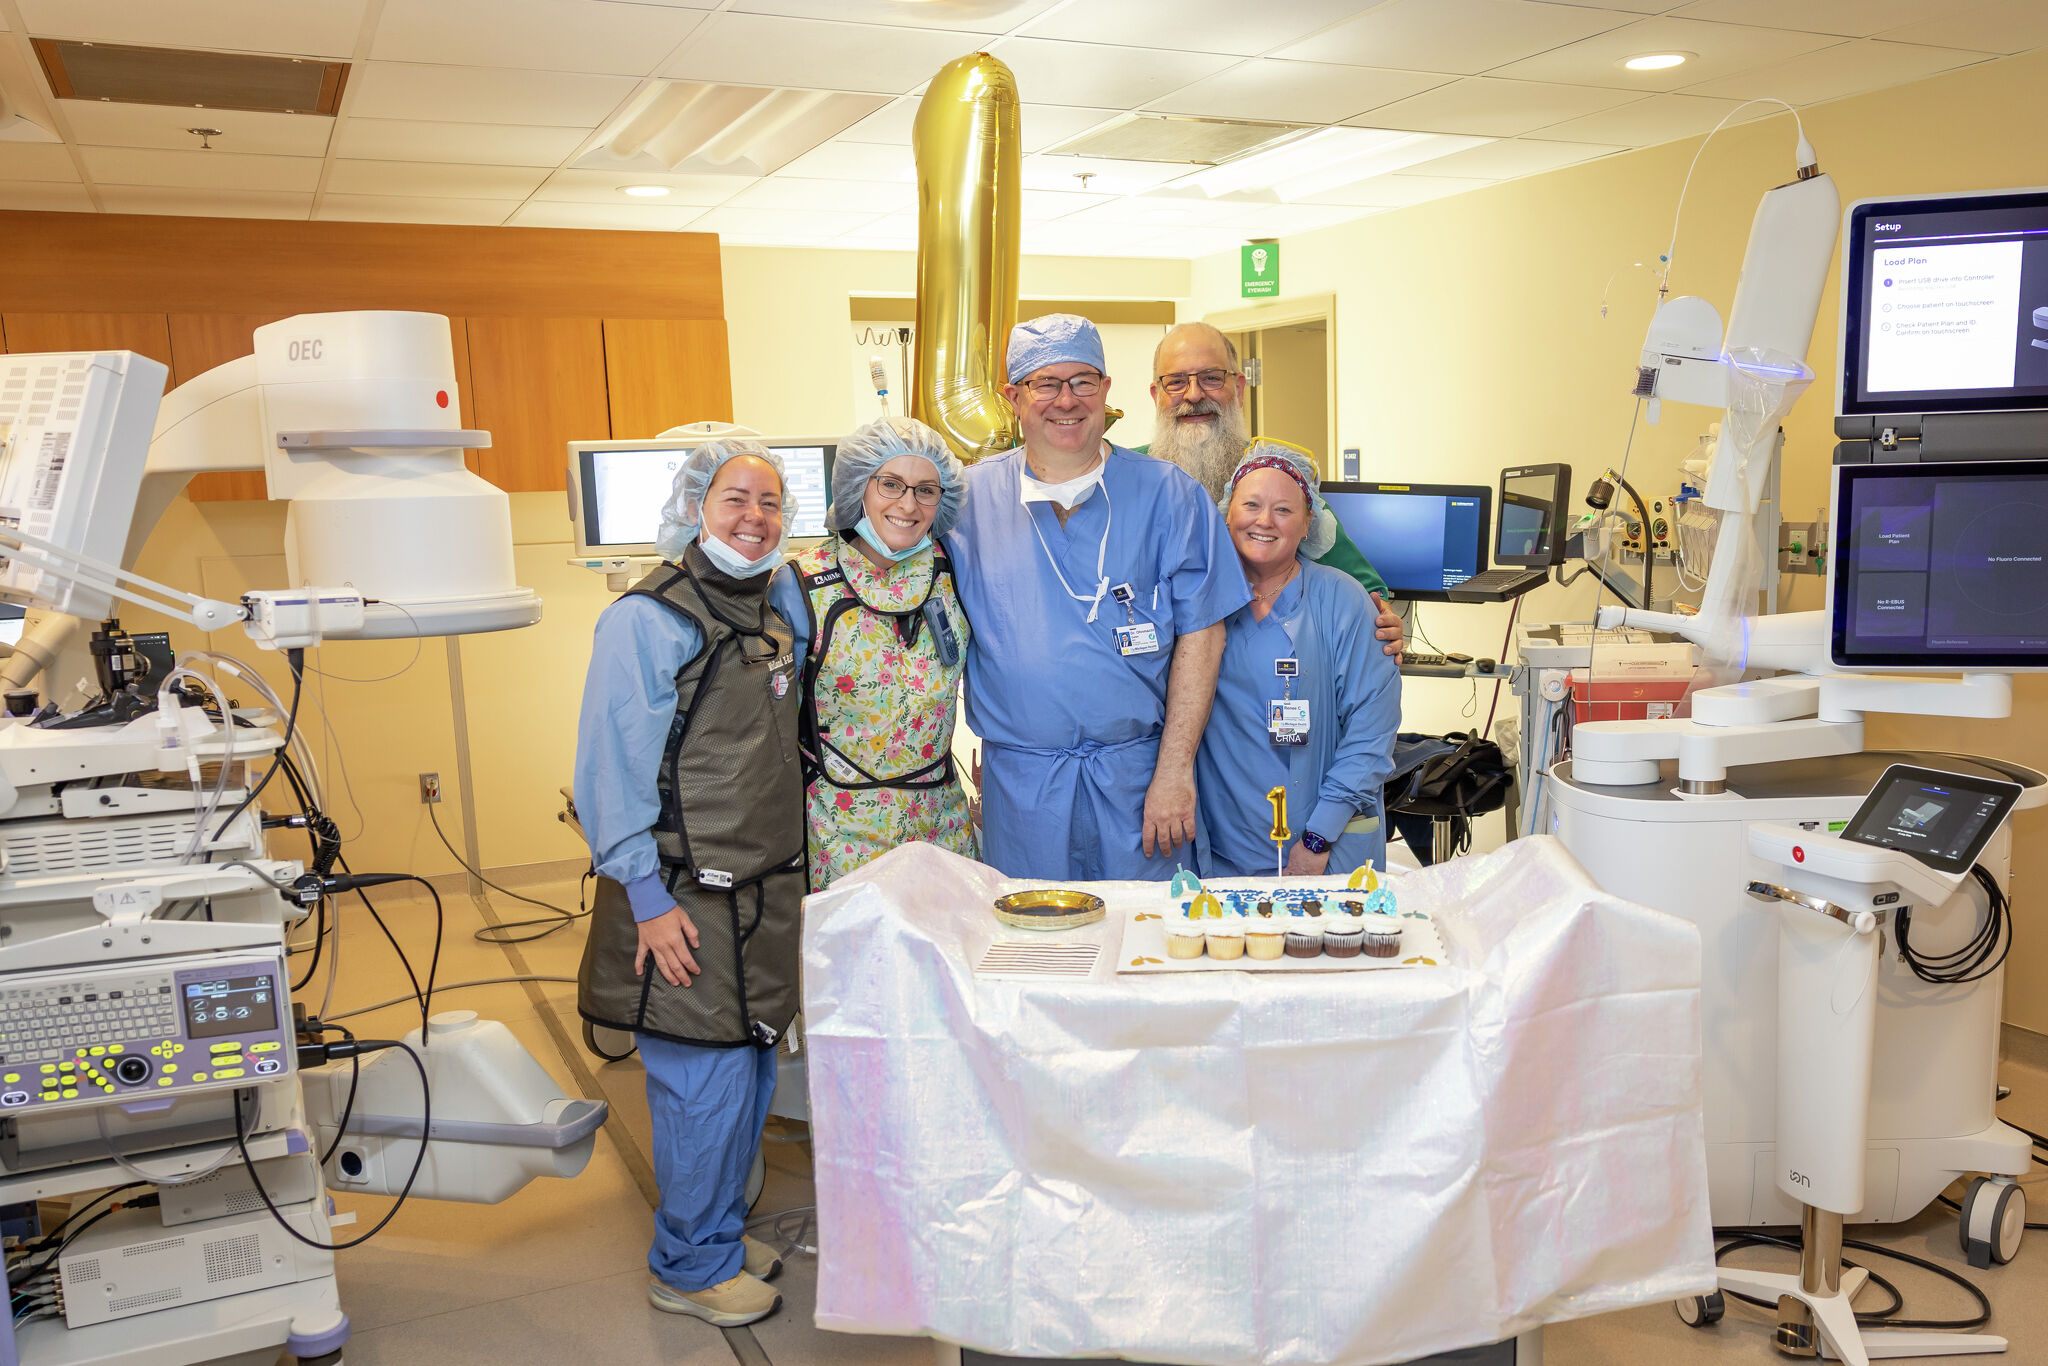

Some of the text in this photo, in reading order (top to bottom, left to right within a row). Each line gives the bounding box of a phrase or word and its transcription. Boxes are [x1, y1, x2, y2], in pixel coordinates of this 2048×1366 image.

[1875, 222, 1902, 233] Setup
[1884, 257, 1928, 266] Load Plan
[289, 339, 323, 361] OEC
[1275, 734, 1302, 743] CRNA
[1266, 786, 1292, 841] 1
